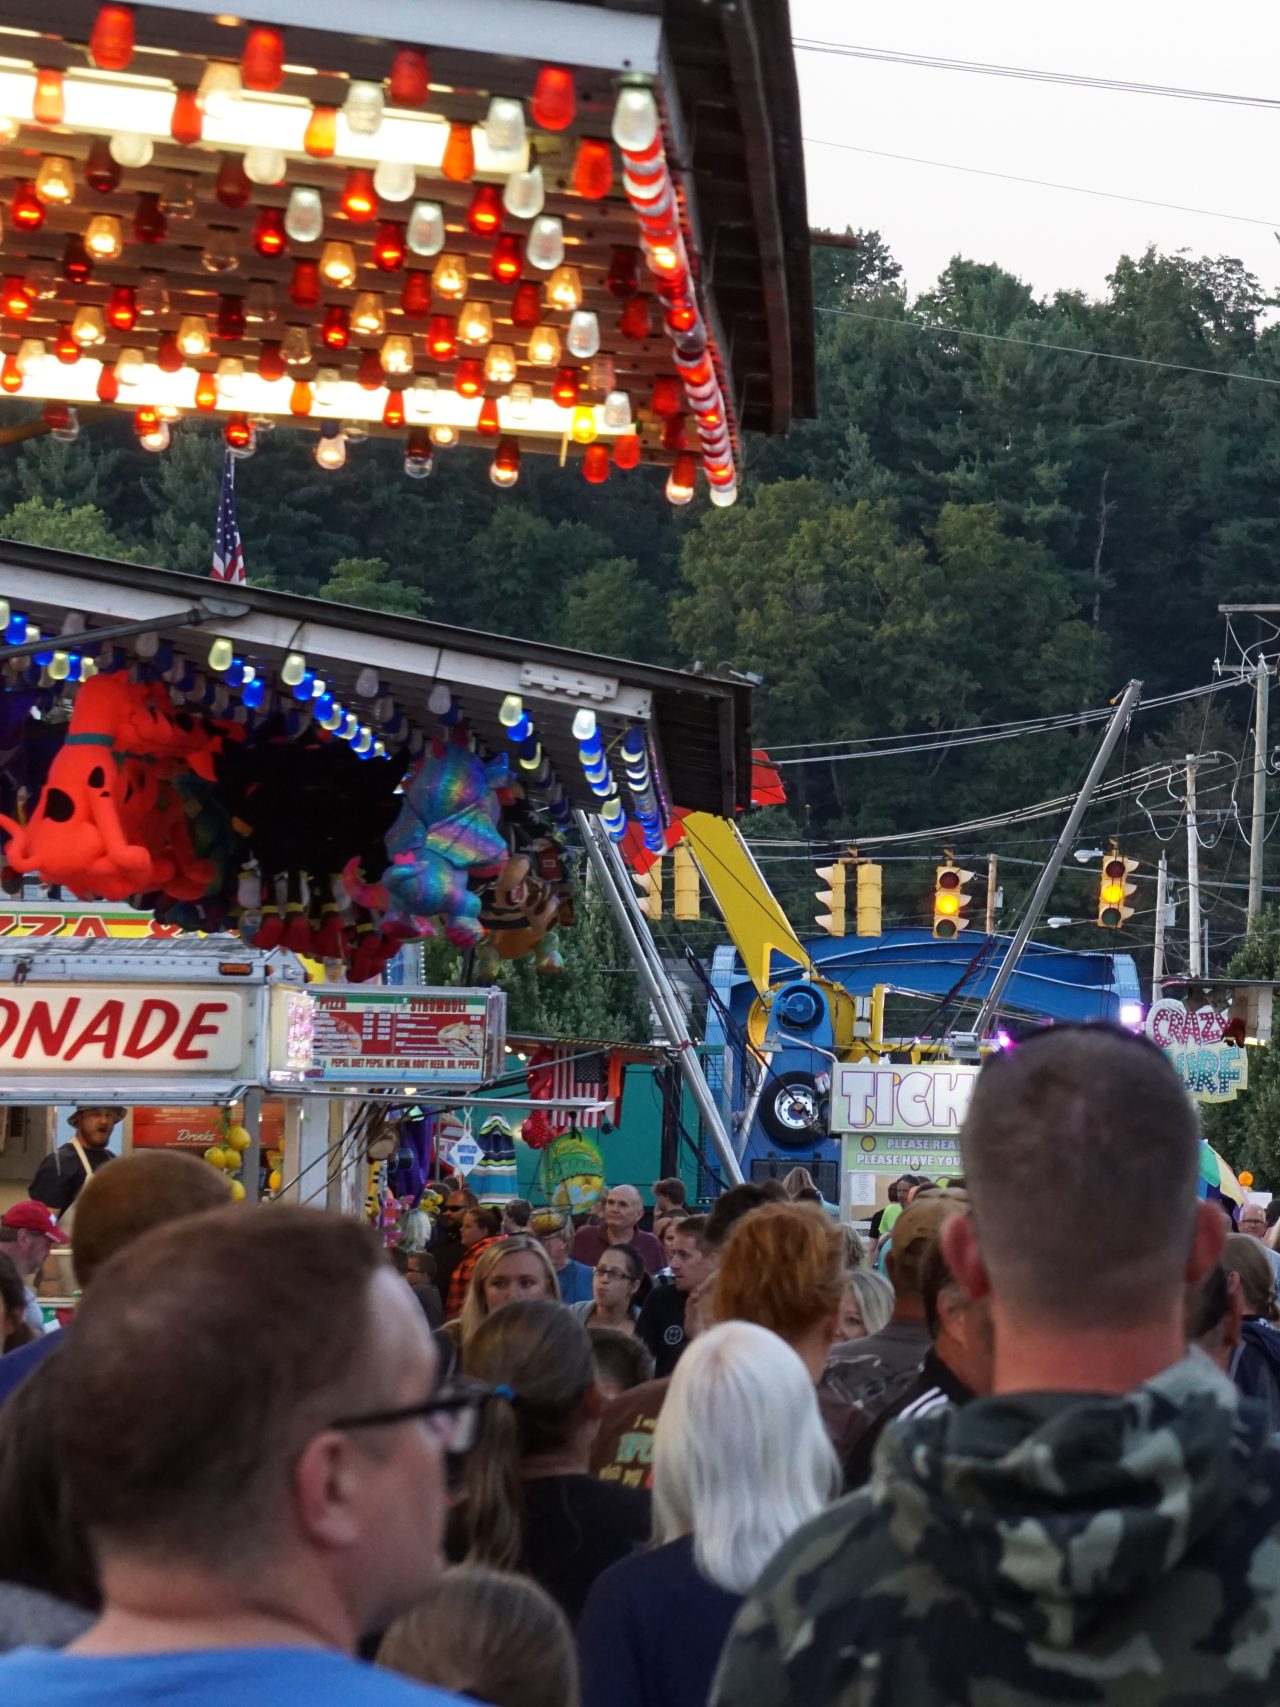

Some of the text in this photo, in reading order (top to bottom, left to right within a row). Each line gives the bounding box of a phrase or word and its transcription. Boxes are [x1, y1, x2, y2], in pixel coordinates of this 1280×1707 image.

[1164, 1047, 1241, 1095] URF
[177, 1128, 216, 1142] Drinks
[887, 1138, 930, 1150] PLEASE
[856, 1153, 899, 1165] PLEASE
[902, 1155, 934, 1166] HAVE
